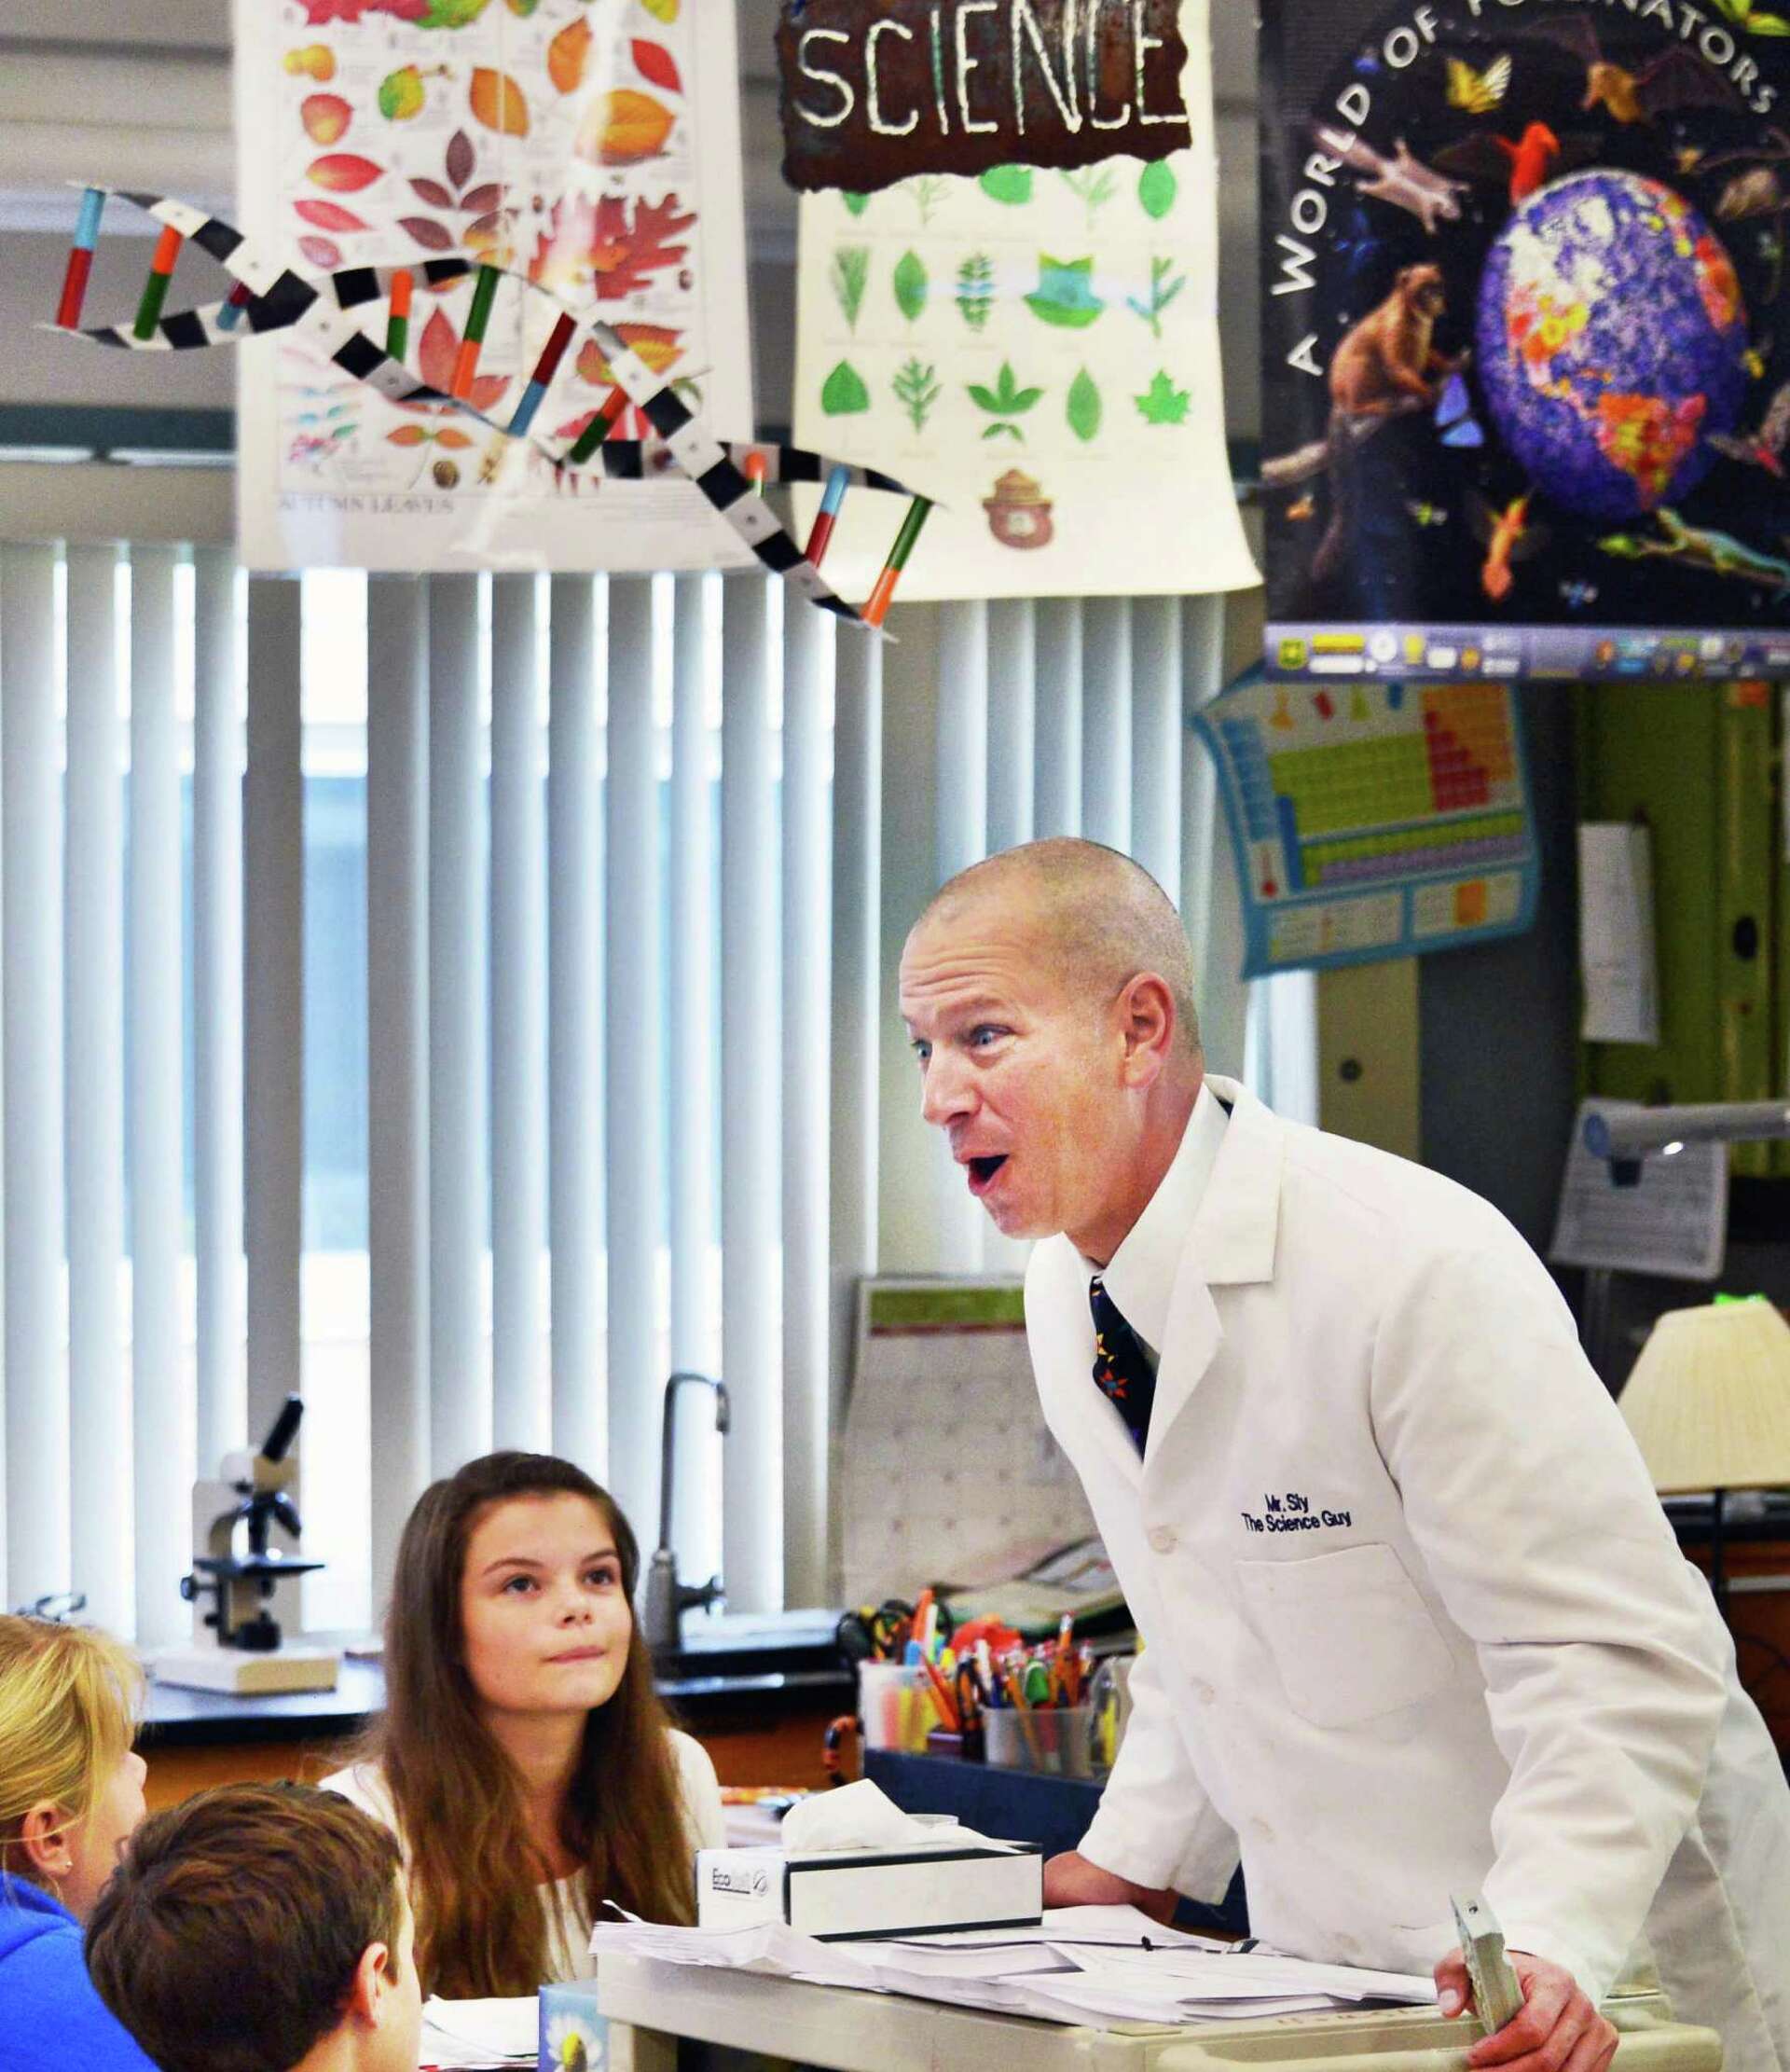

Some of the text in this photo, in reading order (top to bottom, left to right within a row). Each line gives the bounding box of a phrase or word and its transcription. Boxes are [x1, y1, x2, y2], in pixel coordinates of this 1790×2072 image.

[794, 0, 1189, 135] SCIENCE
[1270, 4, 1439, 376] A WORLD OF
[1241, 1510, 1352, 1533] The Science Guy
[1264, 1493, 1309, 1513] Mr. Sly
